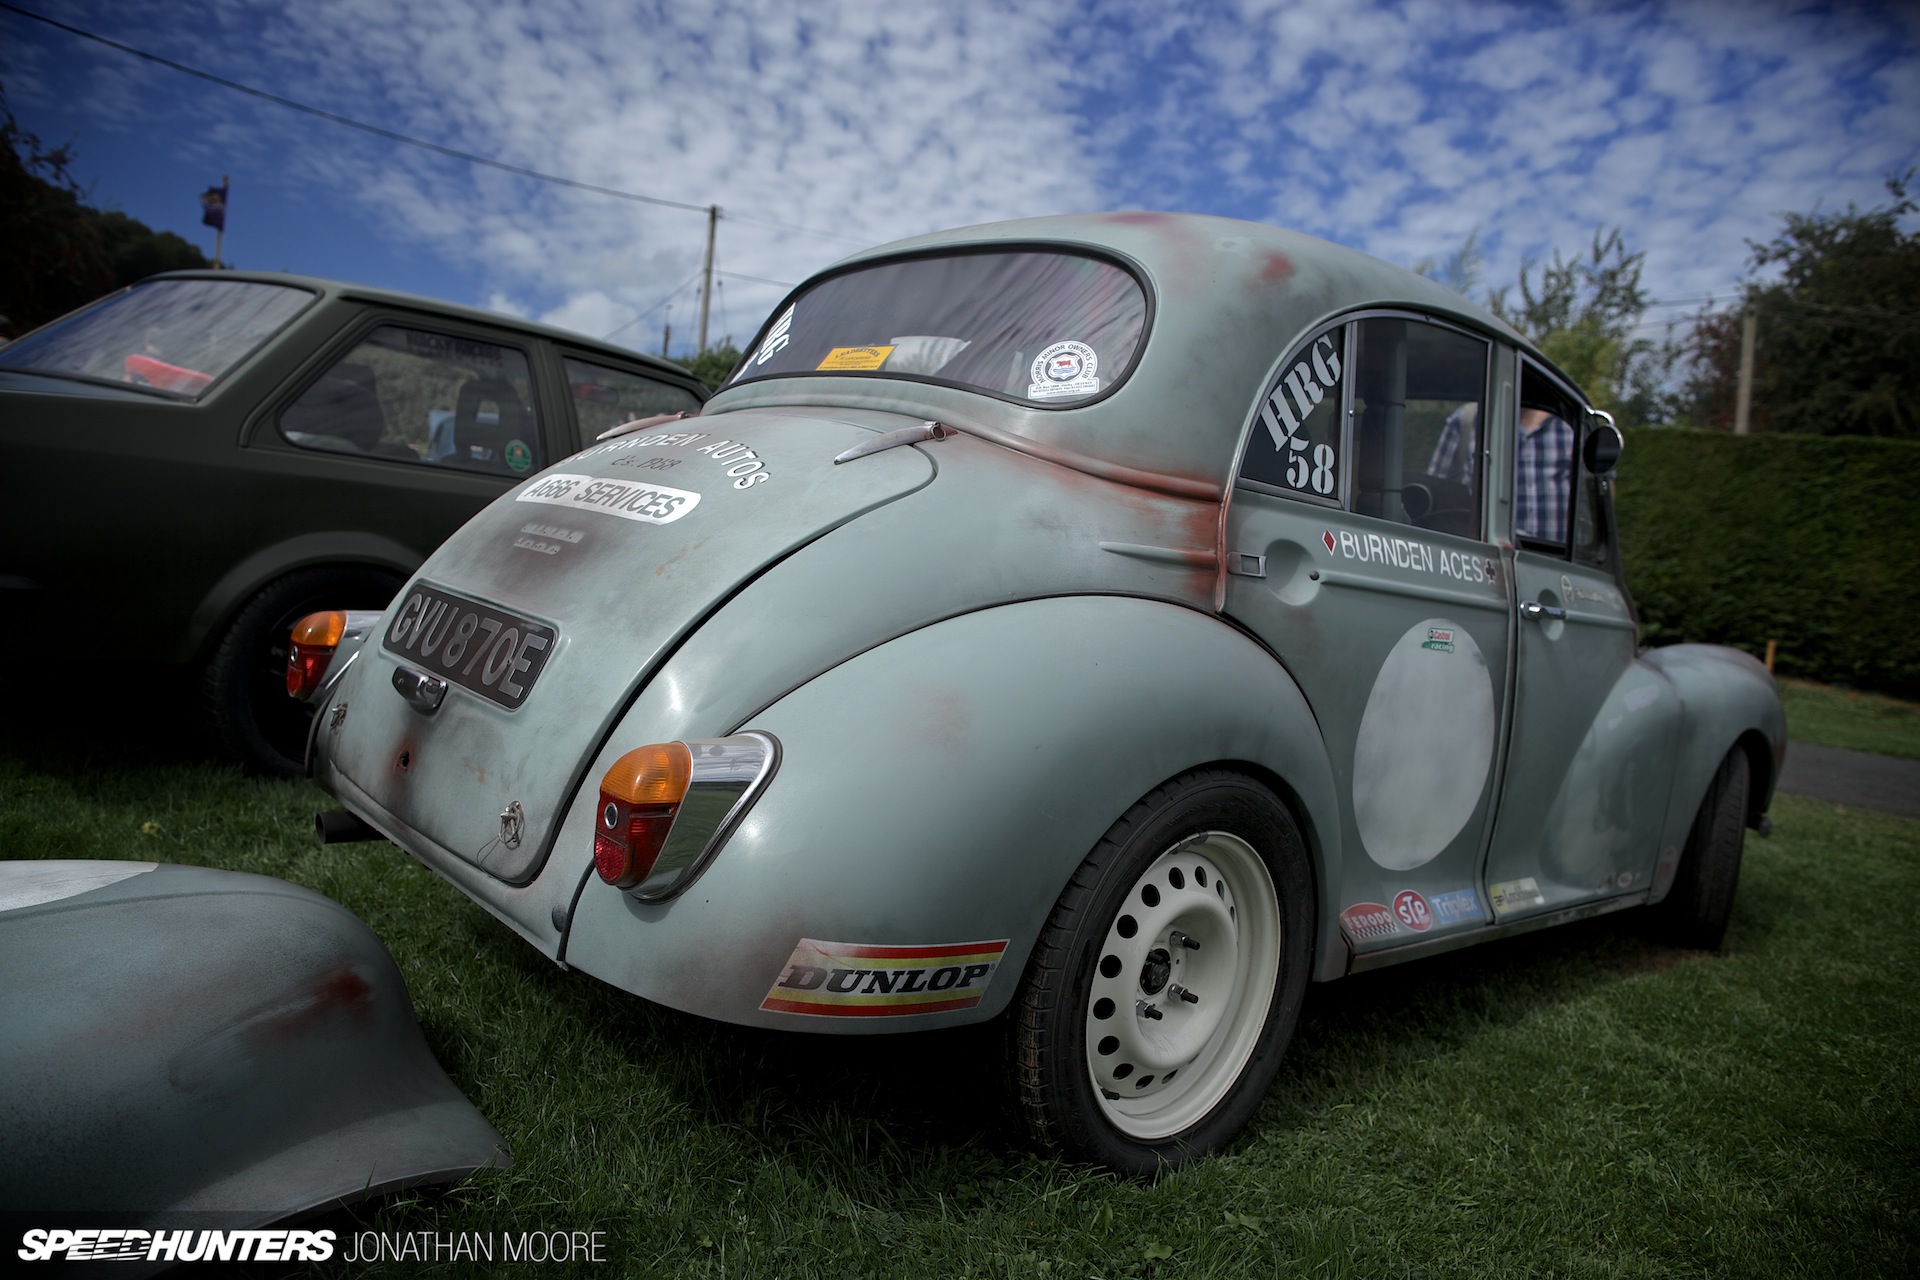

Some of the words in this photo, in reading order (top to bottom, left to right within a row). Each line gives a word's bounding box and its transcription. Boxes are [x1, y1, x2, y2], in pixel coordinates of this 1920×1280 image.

[1035, 361, 1046, 384] MORRIS
[1042, 344, 1066, 360] MINOR
[1067, 344, 1093, 361] OWNERS
[1082, 362, 1094, 379] CLUB
[1260, 334, 1341, 452] HRG
[696, 440, 771, 490] AUTOS
[1286, 436, 1335, 494] 58
[524, 479, 580, 499] A666
[573, 481, 686, 518] SERVICES
[1339, 531, 1434, 573] BURNDEN
[1440, 550, 1484, 583] ACES
[1343, 911, 1393, 929] FERODO
[1399, 895, 1426, 925] STP
[1431, 894, 1478, 917] Triplex
[777, 963, 990, 994] DUNLOP
